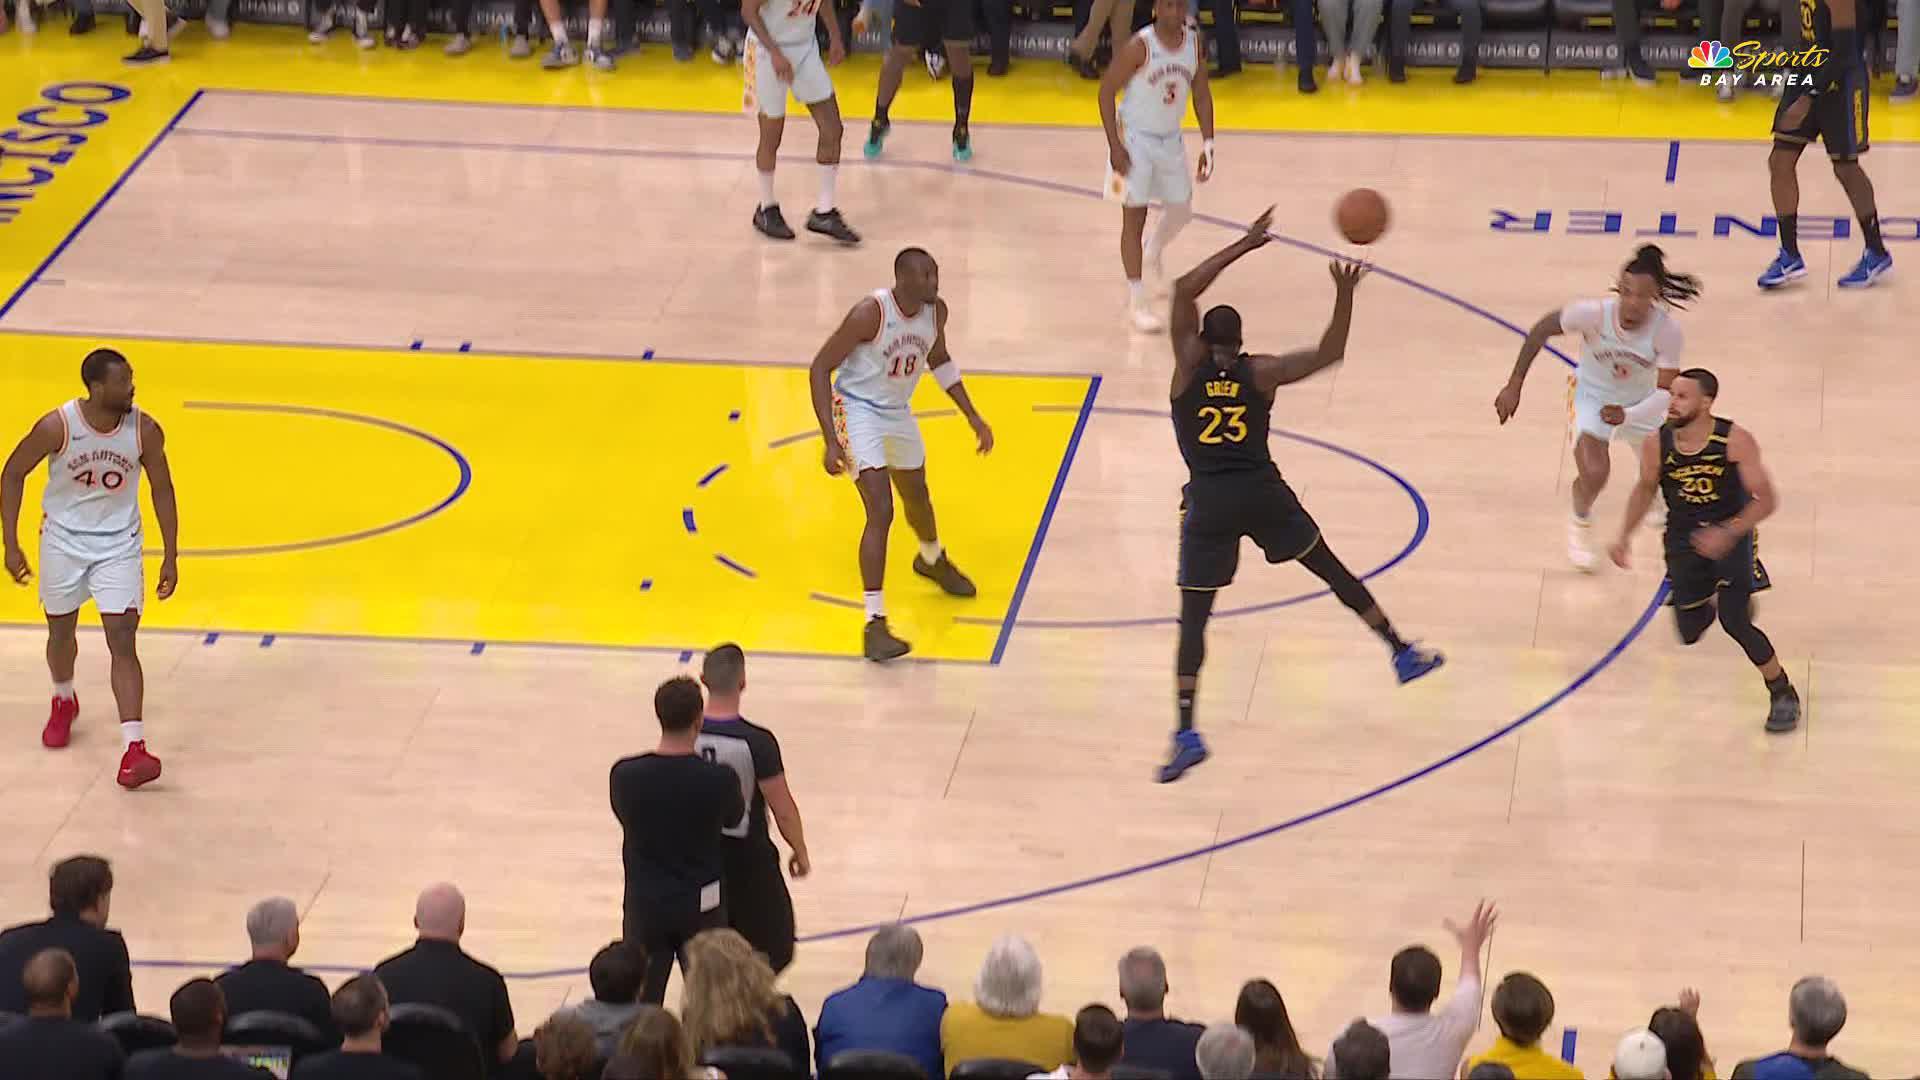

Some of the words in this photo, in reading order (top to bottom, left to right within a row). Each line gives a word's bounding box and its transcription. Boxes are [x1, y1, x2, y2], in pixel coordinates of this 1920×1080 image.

[1475, 42, 1523, 58] CHASE
[1555, 43, 1605, 60] CHASE
[1489, 208, 1920, 241] CENTER
[887, 354, 918, 378] 18
[1205, 380, 1241, 398] GREEN
[1197, 405, 1249, 445] 23
[74, 470, 125, 490] 40
[1668, 464, 1726, 480] GOLDEN
[1681, 477, 1715, 494] 30
